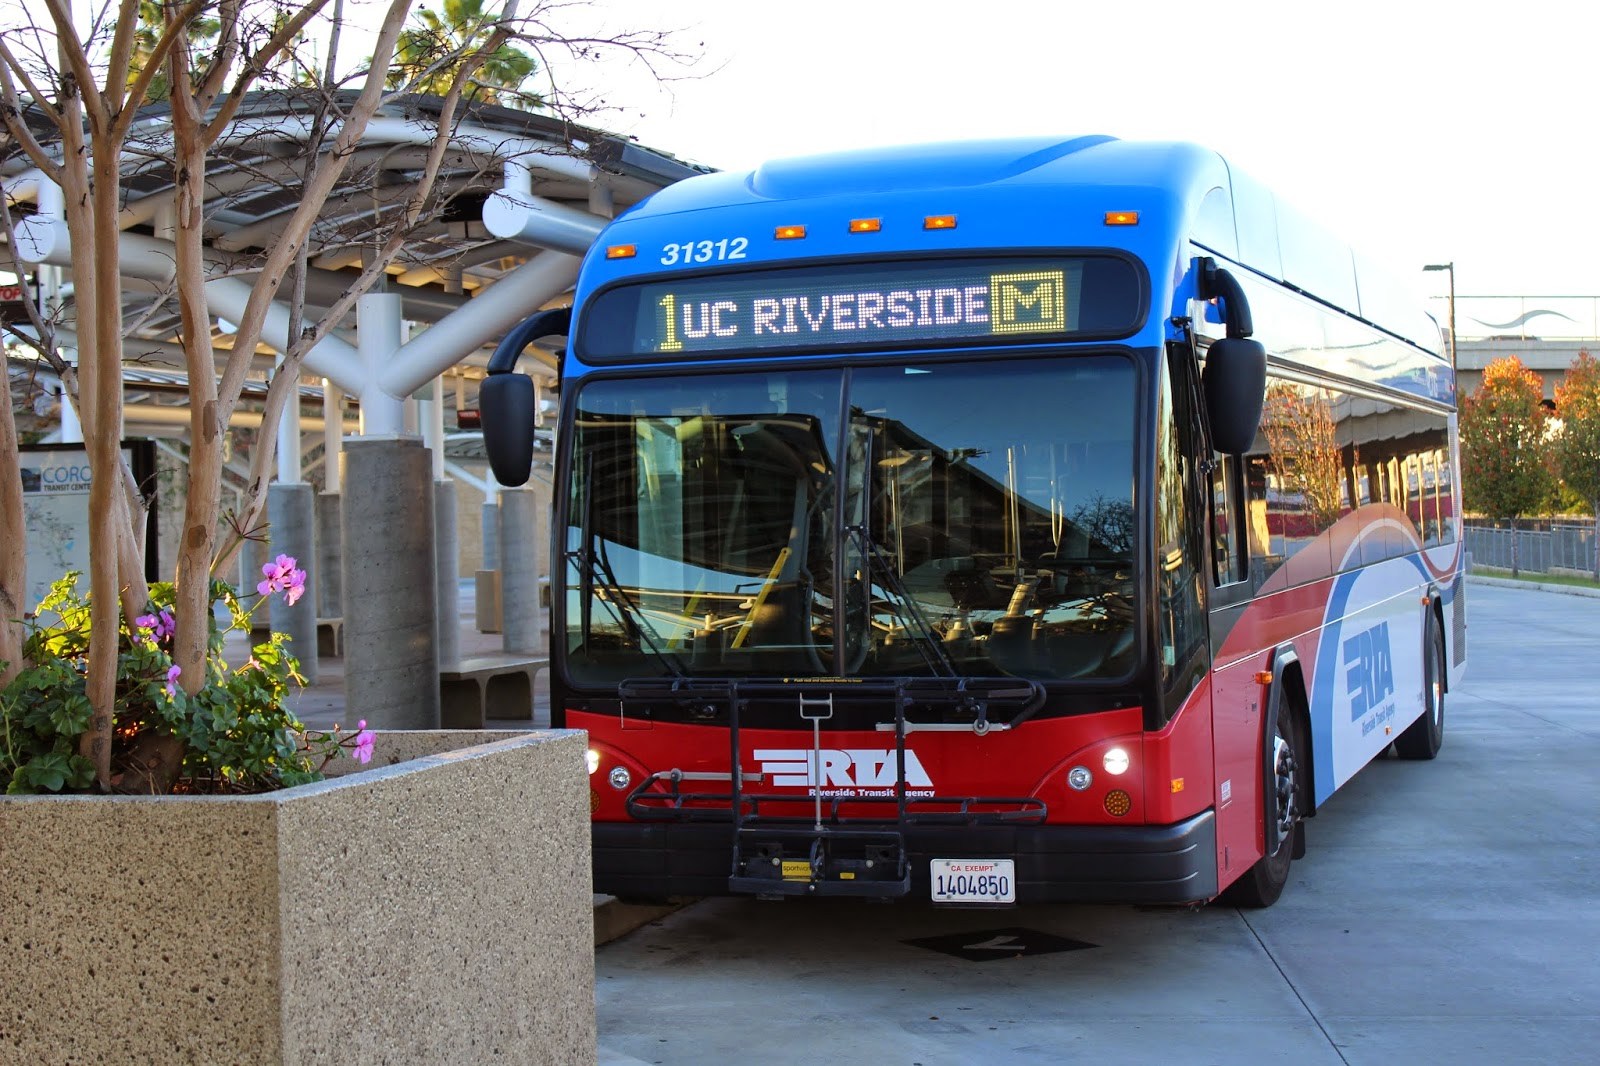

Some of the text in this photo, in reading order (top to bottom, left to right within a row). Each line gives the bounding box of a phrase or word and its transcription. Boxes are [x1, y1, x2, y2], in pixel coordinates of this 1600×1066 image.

[660, 237, 749, 266] 31312
[659, 294, 683, 350] 1
[683, 301, 738, 338] UC
[753, 286, 989, 335] RIVERSIDE
[809, 788, 935, 798] Rverside Transit gency
[937, 874, 1009, 896] 1404850
